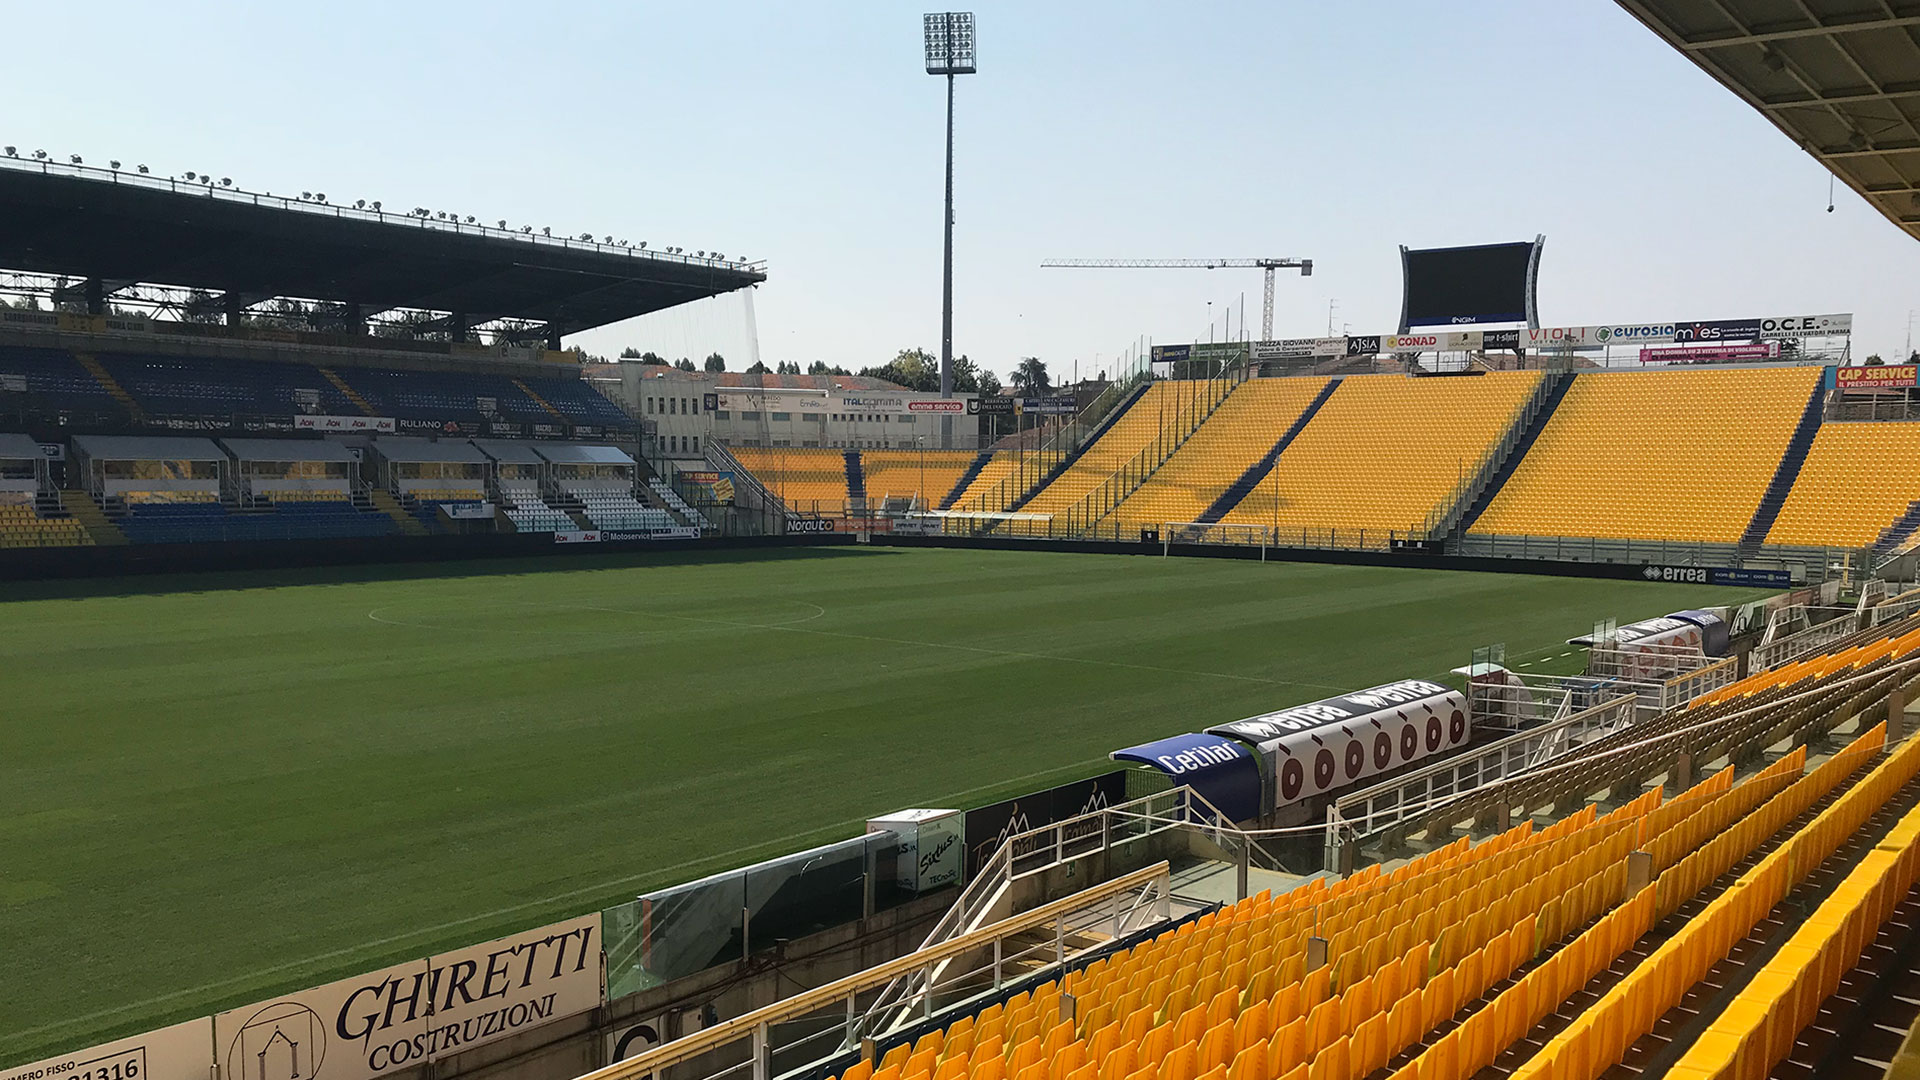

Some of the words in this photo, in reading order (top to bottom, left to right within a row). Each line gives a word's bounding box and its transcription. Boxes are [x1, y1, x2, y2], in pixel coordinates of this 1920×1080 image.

[1614, 325, 1674, 337] eurosia
[1762, 317, 1821, 332] O.C.E.
[1528, 328, 1585, 341] VIOLI
[1282, 339, 1316, 347] GIOVANNI
[1397, 336, 1437, 347] CONAD
[1838, 368, 1863, 380] CAP
[1865, 367, 1916, 380] SERVICE
[1846, 380, 1879, 388] PRESTITO
[400, 419, 441, 428] RULIANO
[787, 519, 833, 532] Norauto
[610, 532, 650, 541] Motoservice
[1663, 566, 1707, 583] errea
[1158, 738, 1239, 776] Cetilar
[335, 925, 595, 1056] GHIRETTI
[369, 992, 557, 1072] COSTRUZIONI
[46, 1061, 76, 1076] FISSO
